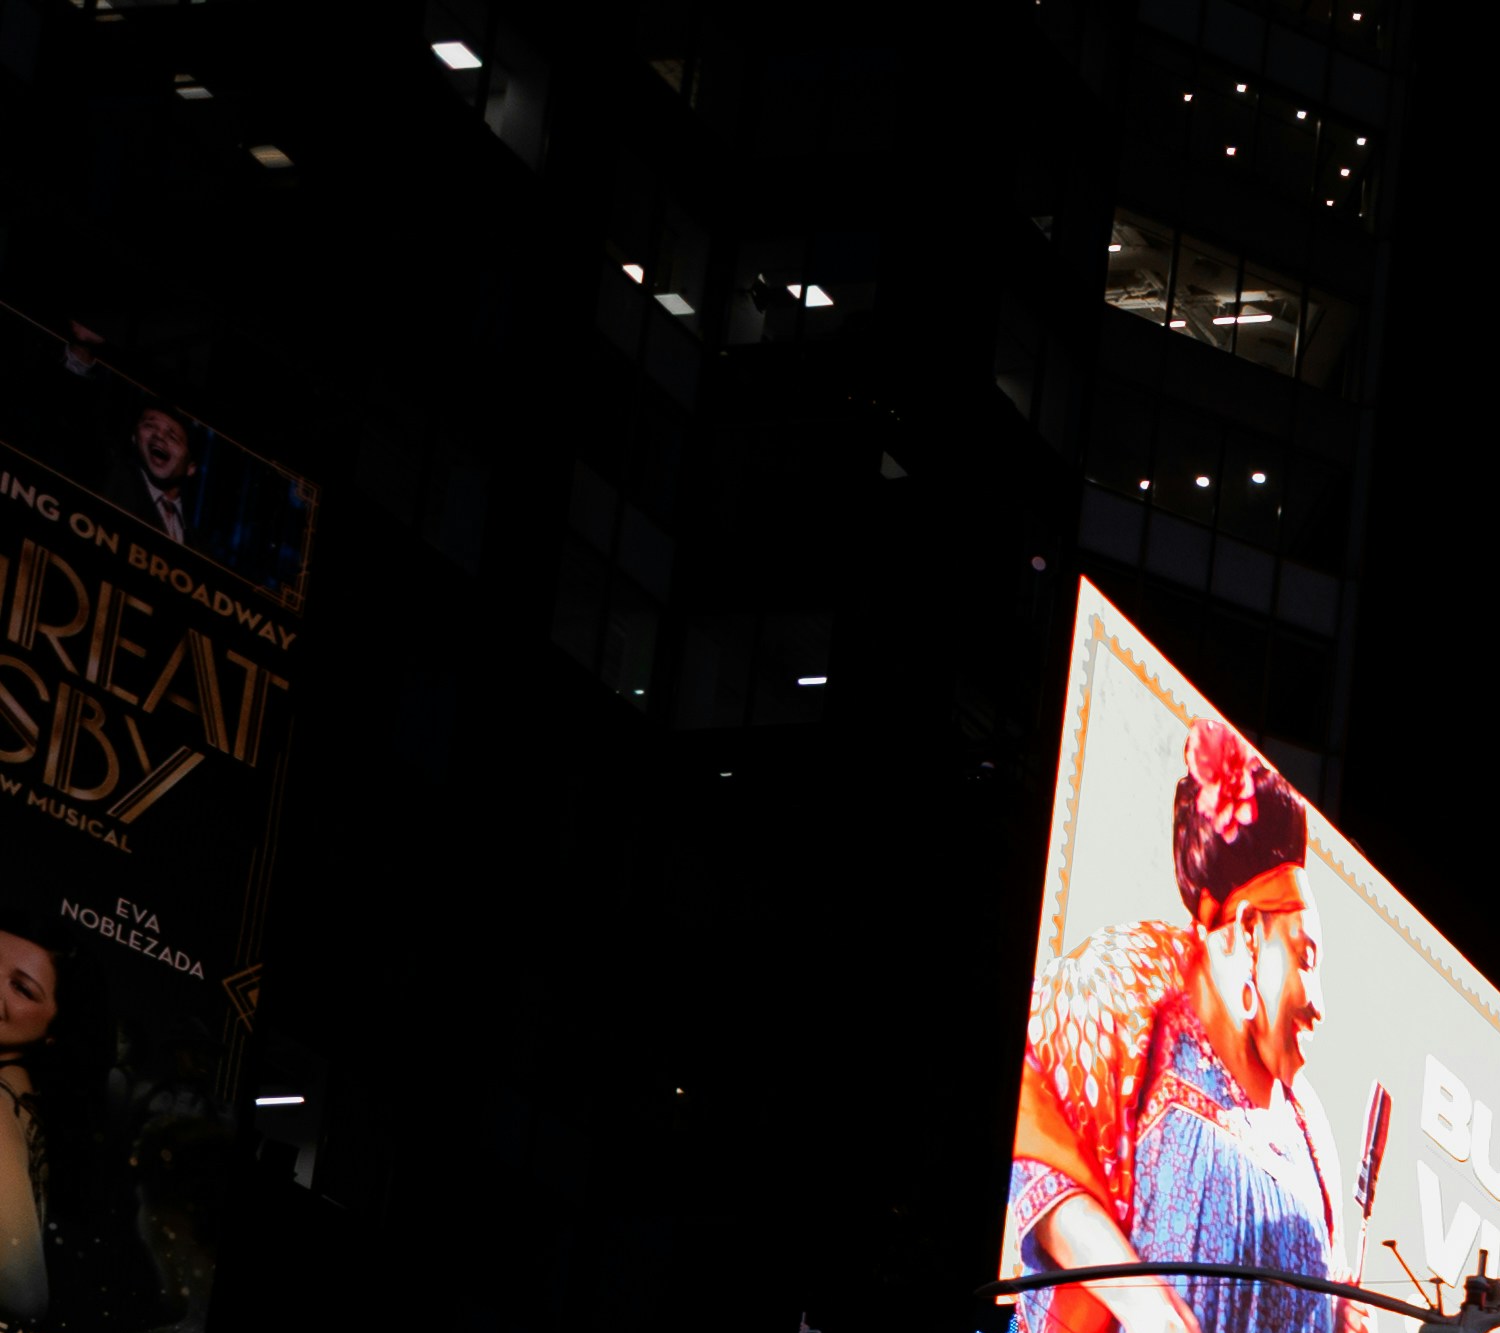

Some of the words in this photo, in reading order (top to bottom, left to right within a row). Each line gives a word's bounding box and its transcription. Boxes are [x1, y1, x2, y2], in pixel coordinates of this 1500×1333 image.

[70, 513, 118, 554] ON
[129, 543, 296, 650] BROADWAY
[0, 538, 289, 768] REAT
[28, 790, 131, 853] MUSICAL
[61, 898, 205, 980] NOBLEZADA
[116, 897, 161, 934] EVA
